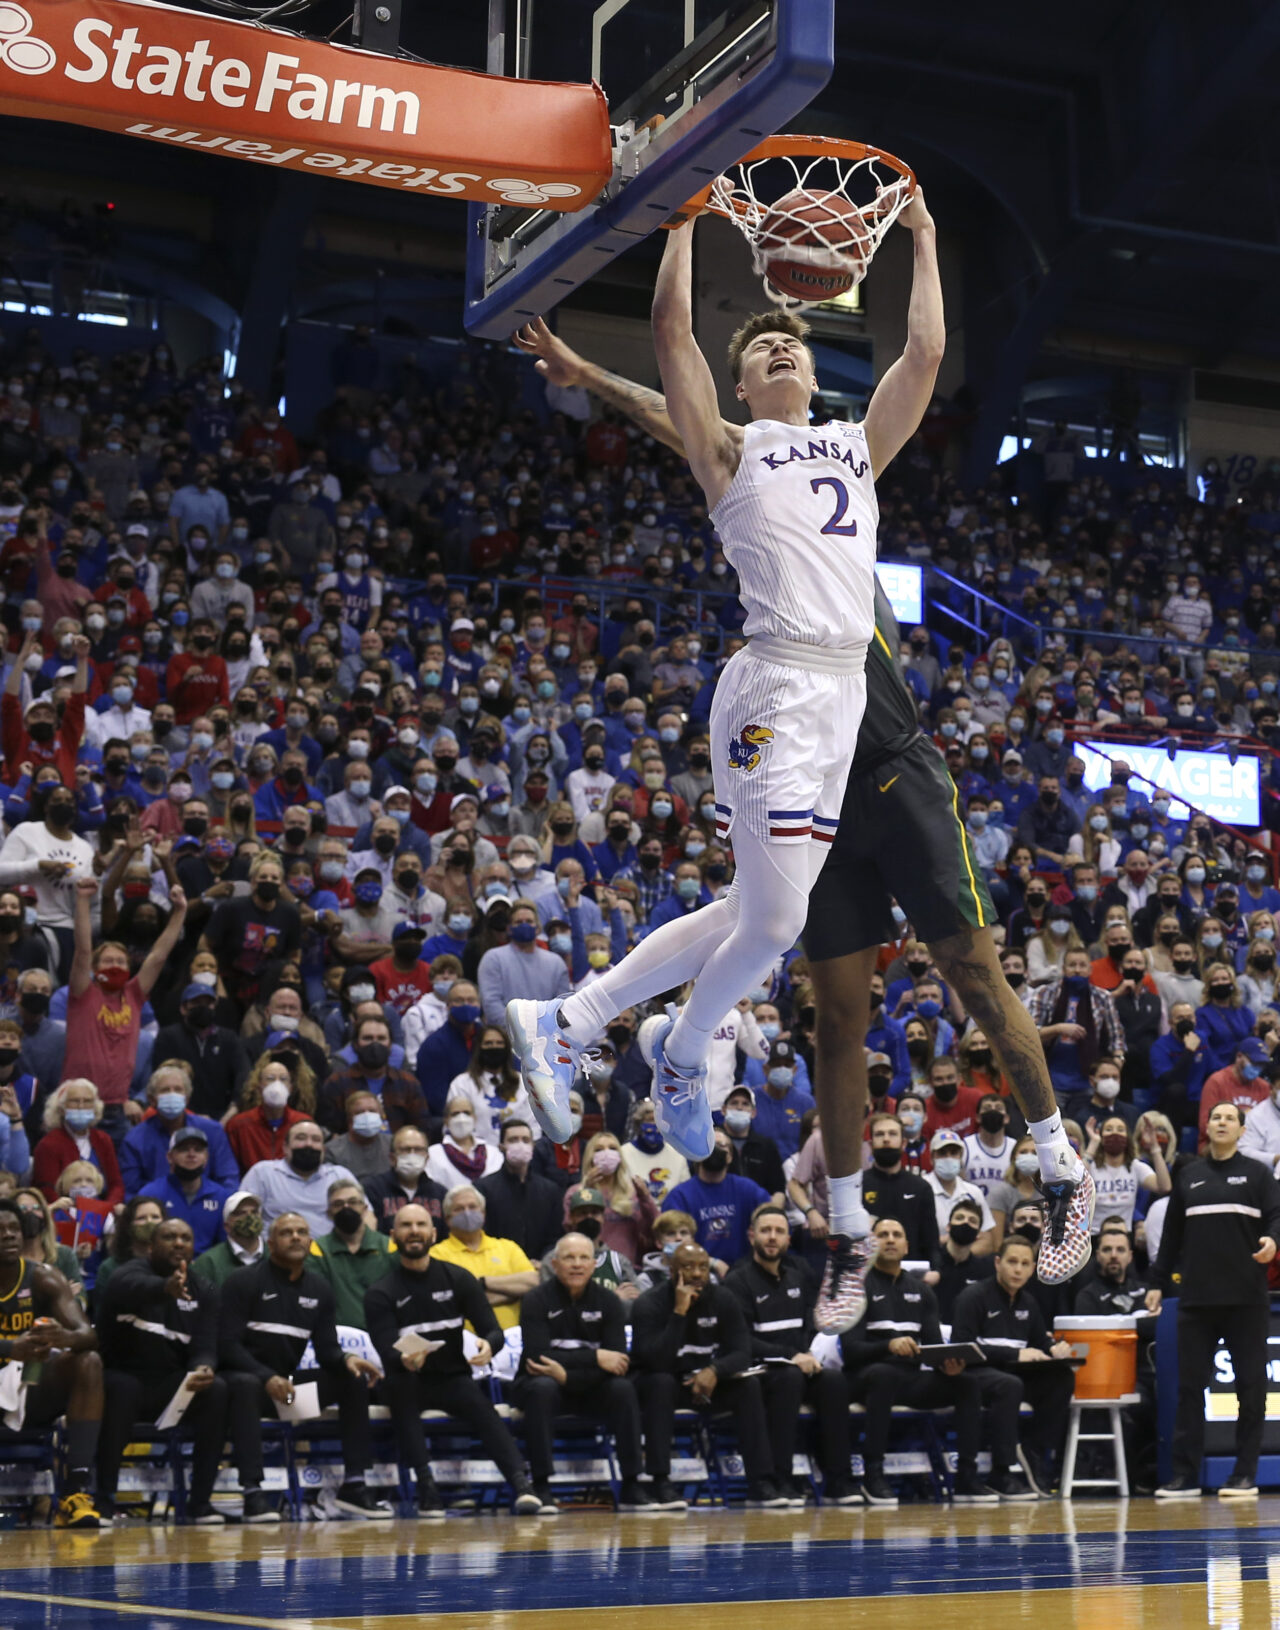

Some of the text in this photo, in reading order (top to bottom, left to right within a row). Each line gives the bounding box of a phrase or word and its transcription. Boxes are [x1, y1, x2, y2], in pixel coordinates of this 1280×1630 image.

[760, 440, 869, 479] KANSAS
[809, 477, 858, 537] 2
[712, 1026, 735, 1041] SAS
[969, 1168, 1004, 1181] KANS
[1, 1311, 34, 1331] LOR
